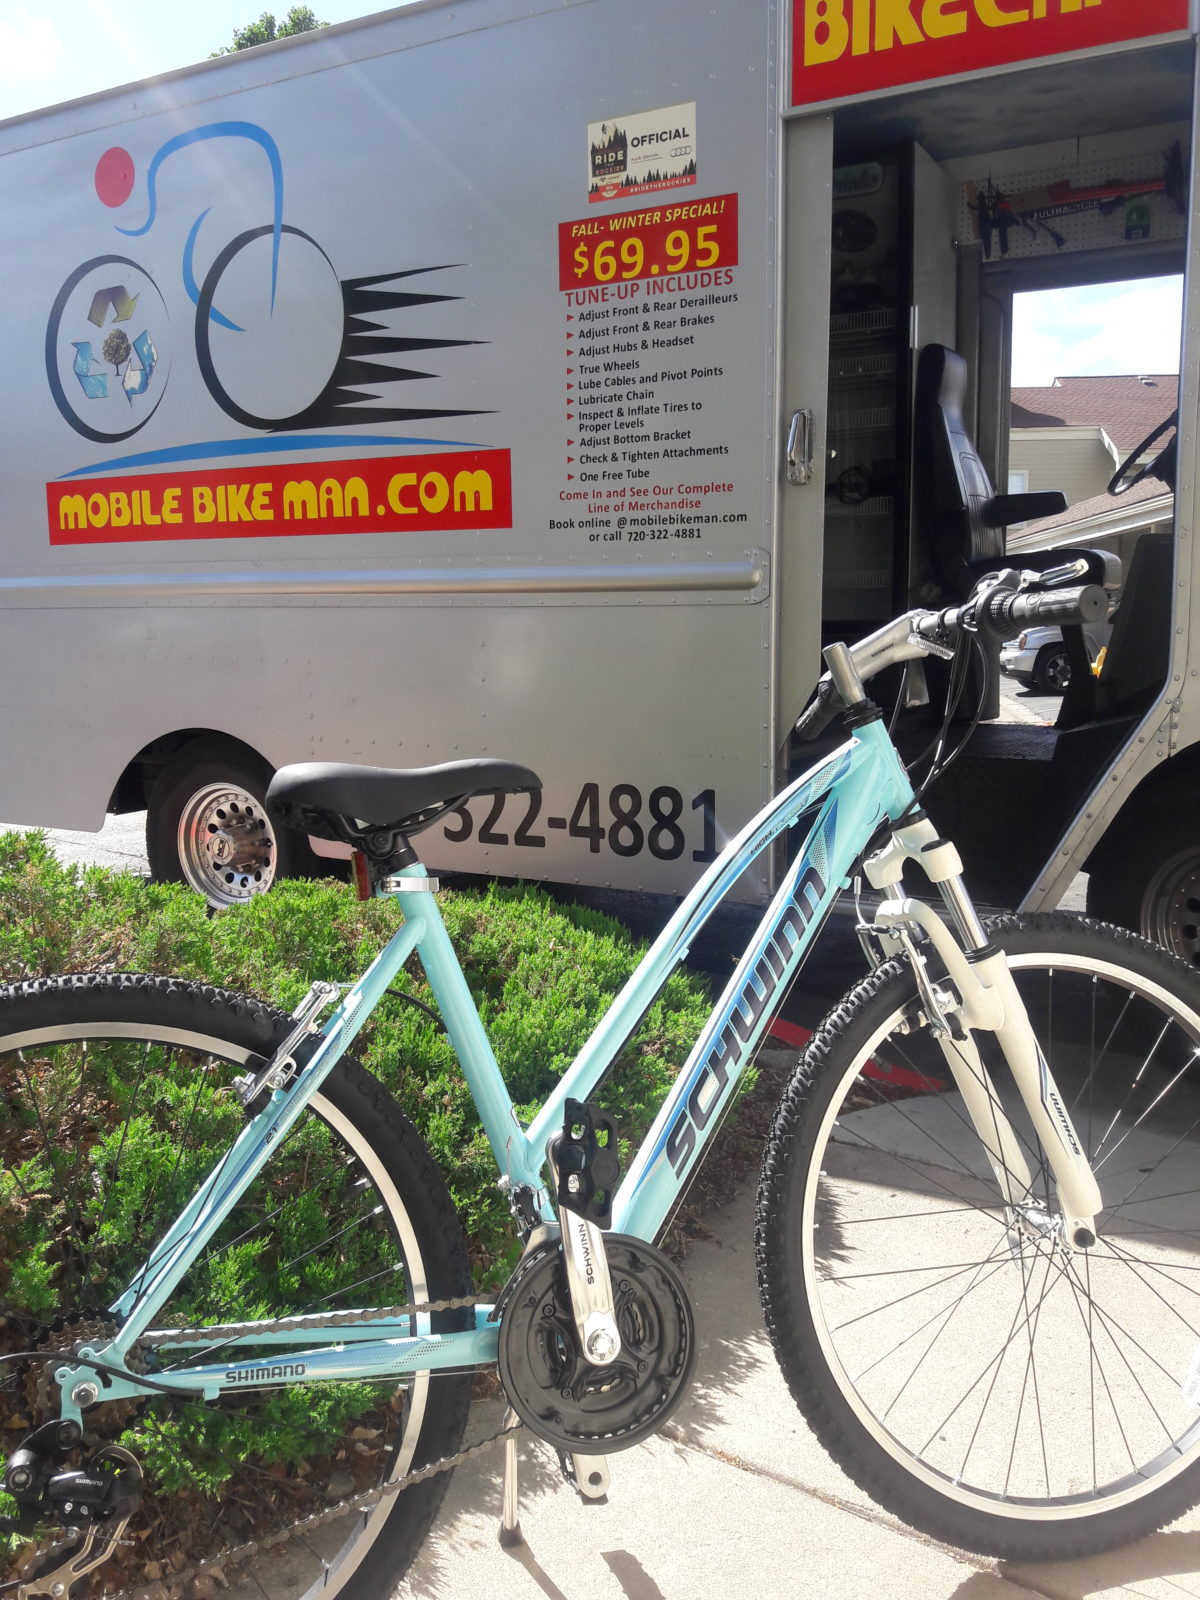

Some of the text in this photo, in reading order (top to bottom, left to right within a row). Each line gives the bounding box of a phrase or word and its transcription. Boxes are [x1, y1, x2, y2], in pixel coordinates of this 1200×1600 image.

[630, 127, 690, 148] OFFICIAL
[595, 150, 624, 165] RIDE
[609, 212, 661, 232] WINTER
[664, 200, 725, 223] SPECIAL!
[573, 224, 720, 282] $69.95
[565, 268, 734, 308] TUNE-UP INCLUDES
[578, 292, 738, 323] Adjust Front & Rear Derailleurs
[578, 313, 715, 341] Adjust Front & Rear Brakes
[578, 335, 694, 358] Adjust Hubs & Headset
[579, 359, 640, 375] True Wheels
[578, 366, 723, 390] Lube Cables and Pivot Points
[578, 389, 654, 406] Lubricate Chain
[578, 401, 702, 422] Inspect & Inflate Tires to
[579, 418, 644, 433] Proper Levels
[580, 429, 691, 449] Adjust Bottom Bracket
[579, 445, 729, 465] Check & Tighten Attachments
[580, 468, 650, 482] One Free Tube
[559, 481, 734, 501] Come In and See Our Complete
[59, 487, 182, 530] MOBILE
[193, 482, 275, 524] BIKE
[588, 498, 702, 514] Line of Merchandise
[549, 517, 575, 530] Book
[578, 516, 611, 529] online
[589, 528, 702, 542] or call 720-322-4881
[666, 866, 826, 1181] SCHWINN
[264, 1126, 279, 1144] 21
[578, 1223, 595, 1285] SCHWINN
[225, 1363, 306, 1383] SHIMANO
